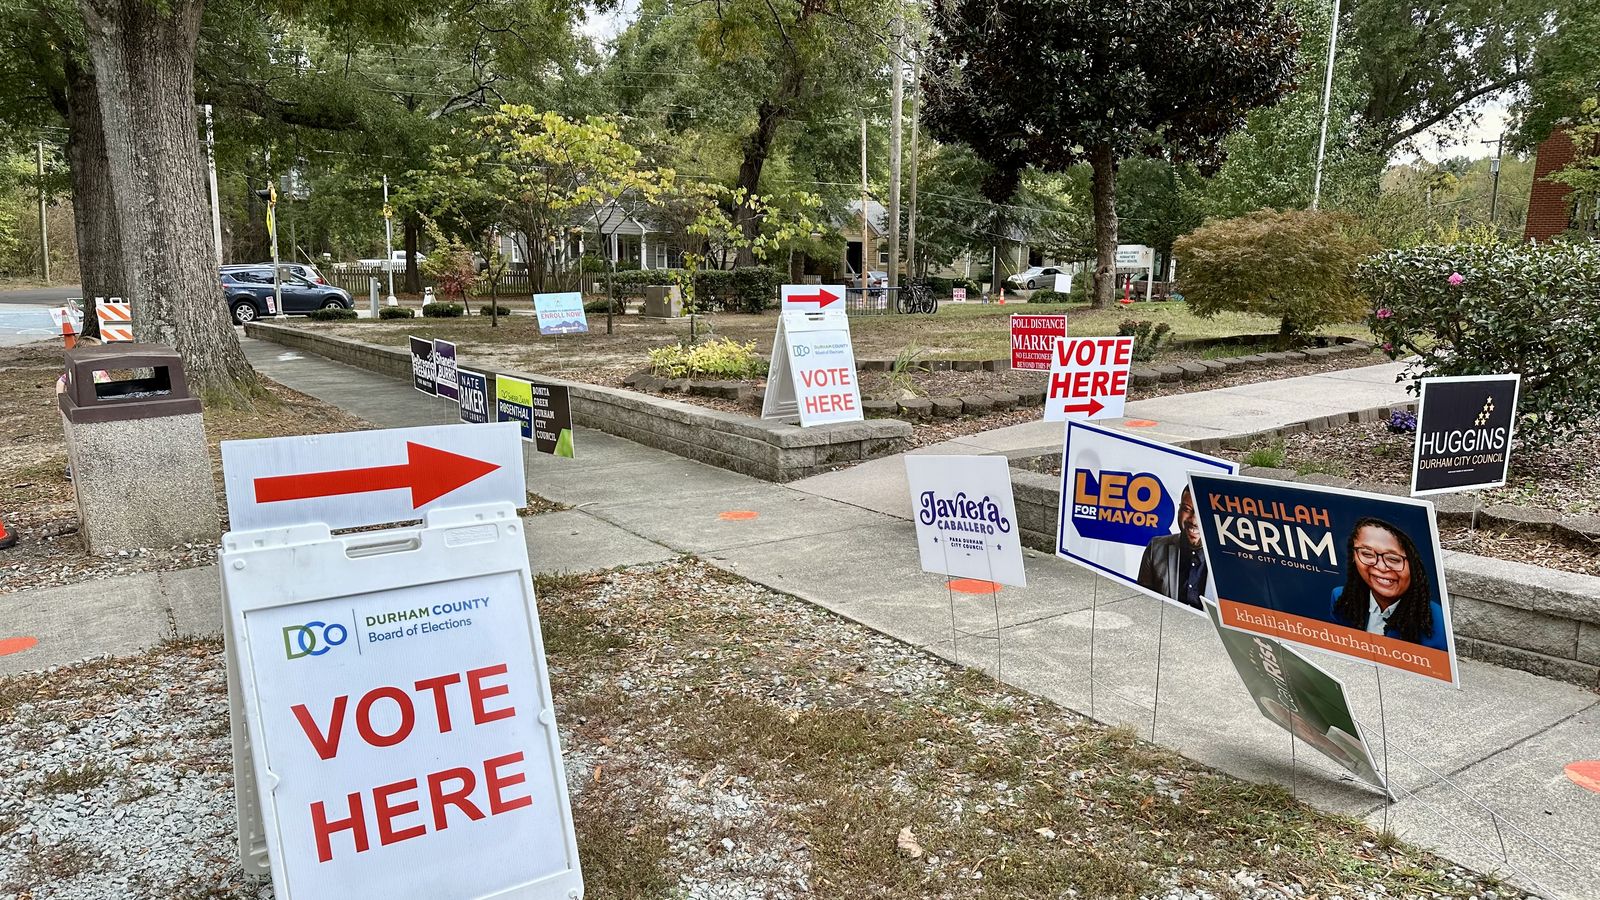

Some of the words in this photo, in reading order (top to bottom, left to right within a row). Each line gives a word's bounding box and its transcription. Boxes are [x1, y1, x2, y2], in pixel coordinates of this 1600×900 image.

[1012, 318, 1029, 328] POLL
[1031, 319, 1065, 329] DISTANCE
[1012, 334, 1056, 350] MARKE
[1057, 340, 1131, 367] VOTE
[438, 364, 457, 382] BURRIS
[461, 375, 480, 389] NATE
[800, 368, 851, 388] VOTE
[532, 386, 550, 396] BONITA
[1050, 371, 1128, 398] HERE
[460, 385, 486, 415] BAKER
[499, 401, 530, 420] ROSENTHAL
[534, 397, 549, 407] GREEN
[805, 393, 855, 414] HERE
[534, 408, 555, 419] DURHAM
[535, 419, 546, 428] CITY
[536, 430, 557, 441] COUNCIL
[1421, 427, 1506, 455] HUGGINS
[1420, 457, 1453, 470] DURHAM
[1453, 455, 1471, 466] CITY
[1472, 453, 1504, 464] COUNCIL
[1075, 472, 1162, 512] LEO
[920, 491, 1010, 533] Javiera
[1074, 504, 1097, 516] FOR
[1098, 508, 1159, 528] MAYOR
[1209, 493, 1331, 528] KHALILAH
[937, 520, 994, 535] CABALLERO
[1214, 514, 1338, 566] KARIM
[1238, 551, 1254, 560] FOR
[1258, 555, 1276, 564] CITY
[1281, 559, 1320, 572] COUNCIL
[365, 607, 430, 627] DURHAM
[432, 597, 490, 616] COUNTY
[368, 626, 404, 643] Board
[406, 623, 418, 636] of
[421, 617, 472, 634] Elections
[1234, 608, 1432, 669] khalilahfordurham.com
[291, 663, 517, 761] VOTE
[309, 751, 533, 863] HERE
